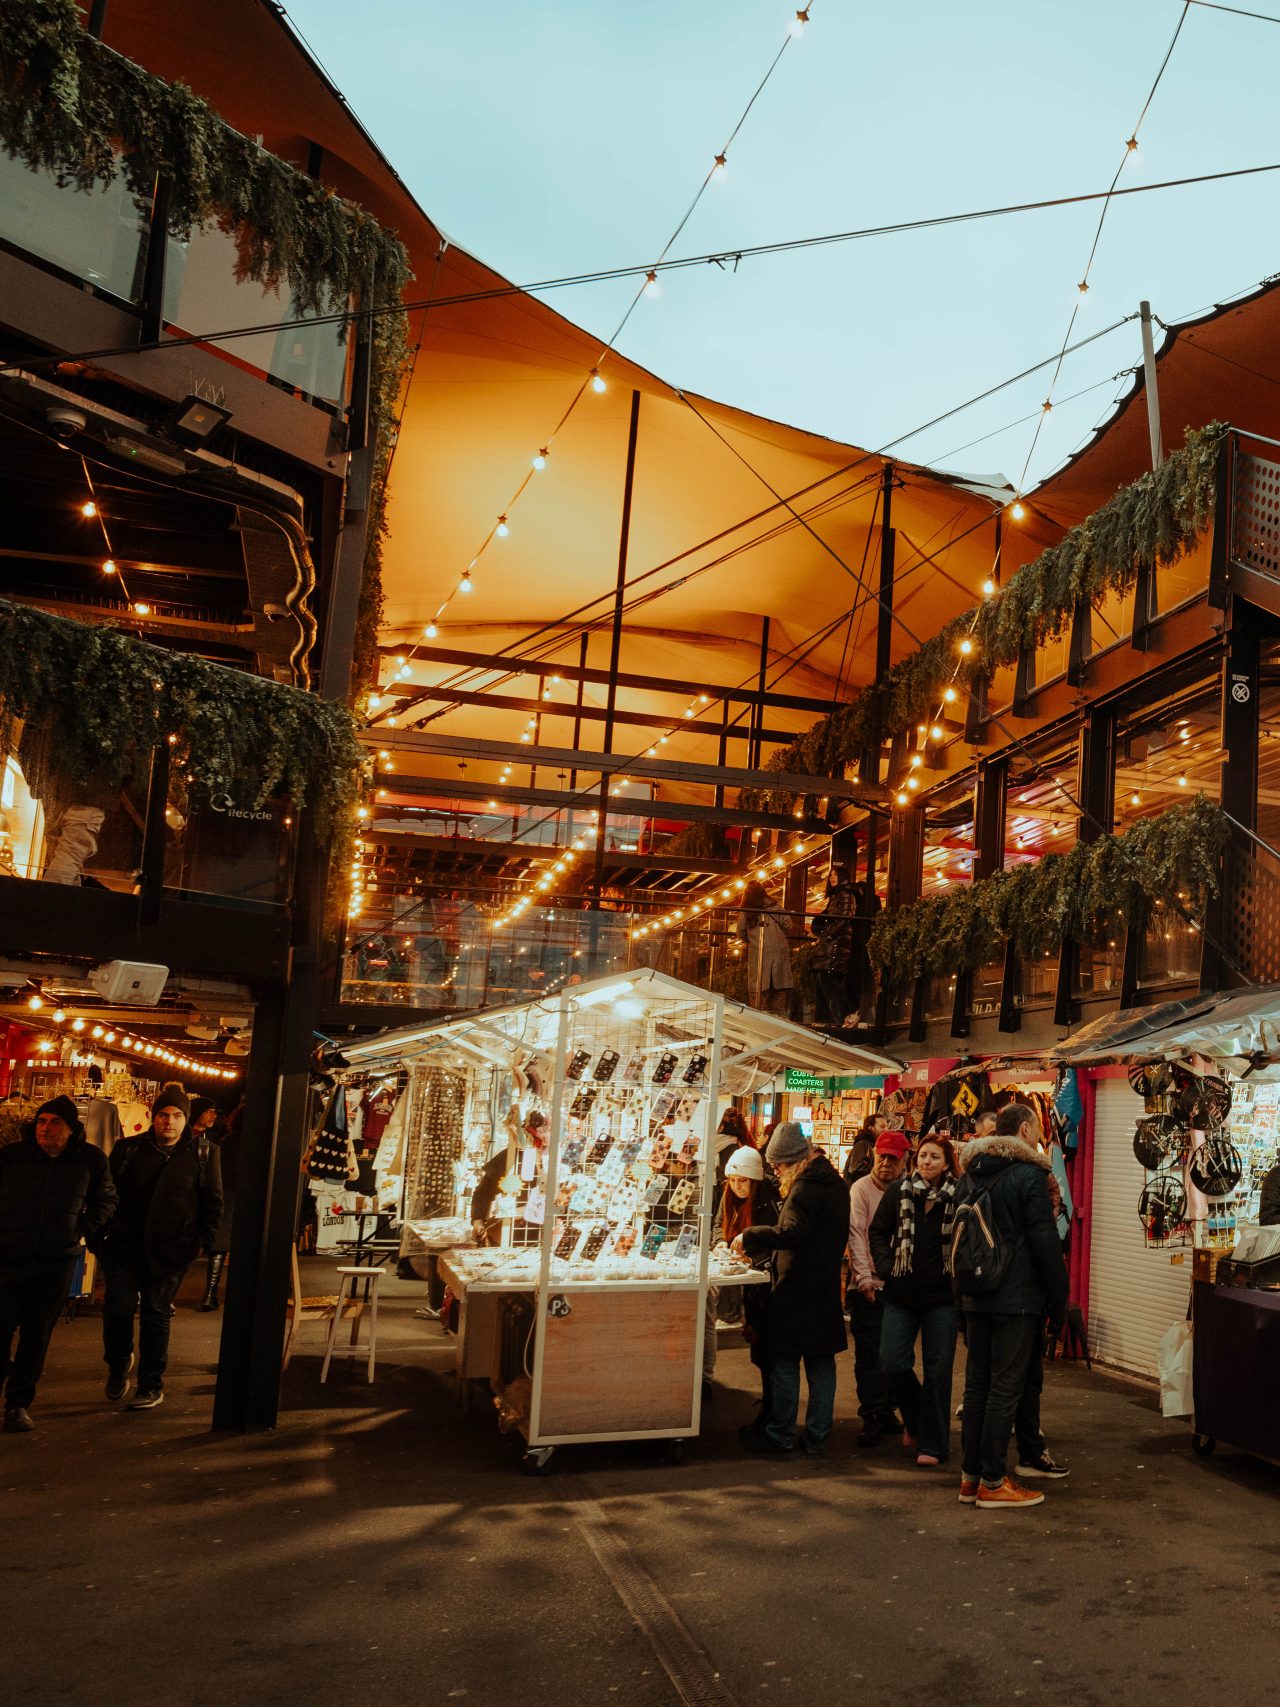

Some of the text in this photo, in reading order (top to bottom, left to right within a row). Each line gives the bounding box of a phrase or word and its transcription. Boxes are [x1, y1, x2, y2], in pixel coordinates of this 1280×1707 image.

[228, 808, 272, 820] Recycle
[788, 1078, 825, 1088] COASTERS
[785, 1086, 825, 1096] MADE HERE
[325, 1207, 331, 1217] I
[322, 1216, 345, 1227] LONDON
[551, 1300, 569, 1315] P3
